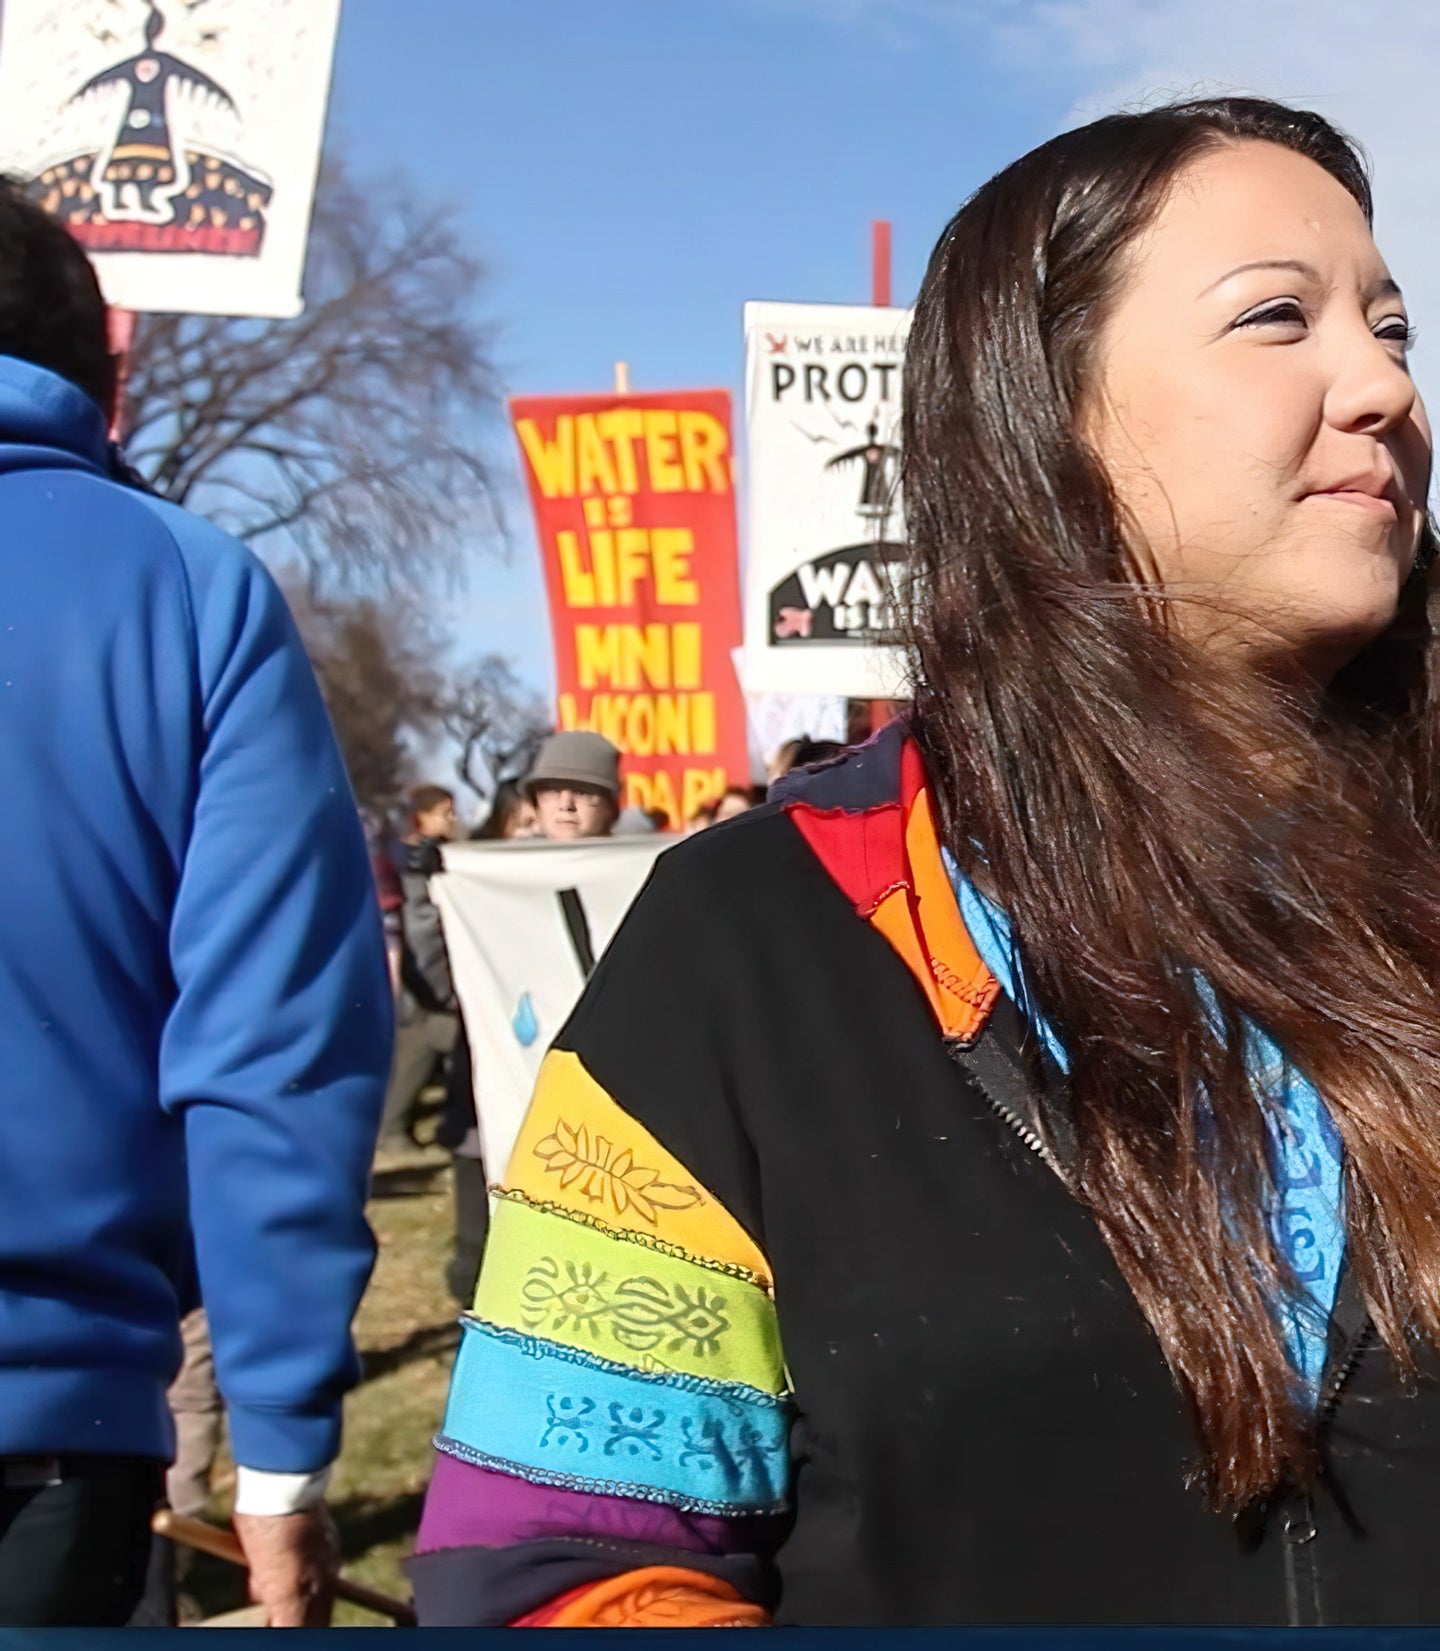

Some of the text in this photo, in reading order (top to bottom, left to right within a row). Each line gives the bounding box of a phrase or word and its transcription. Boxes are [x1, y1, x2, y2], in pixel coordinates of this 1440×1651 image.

[794, 335, 822, 354] WE
[831, 335, 868, 353] ARE
[771, 362, 897, 402] PROT
[515, 409, 728, 498] WATER
[556, 528, 699, 608] LIFE
[574, 622, 702, 690] MNI
